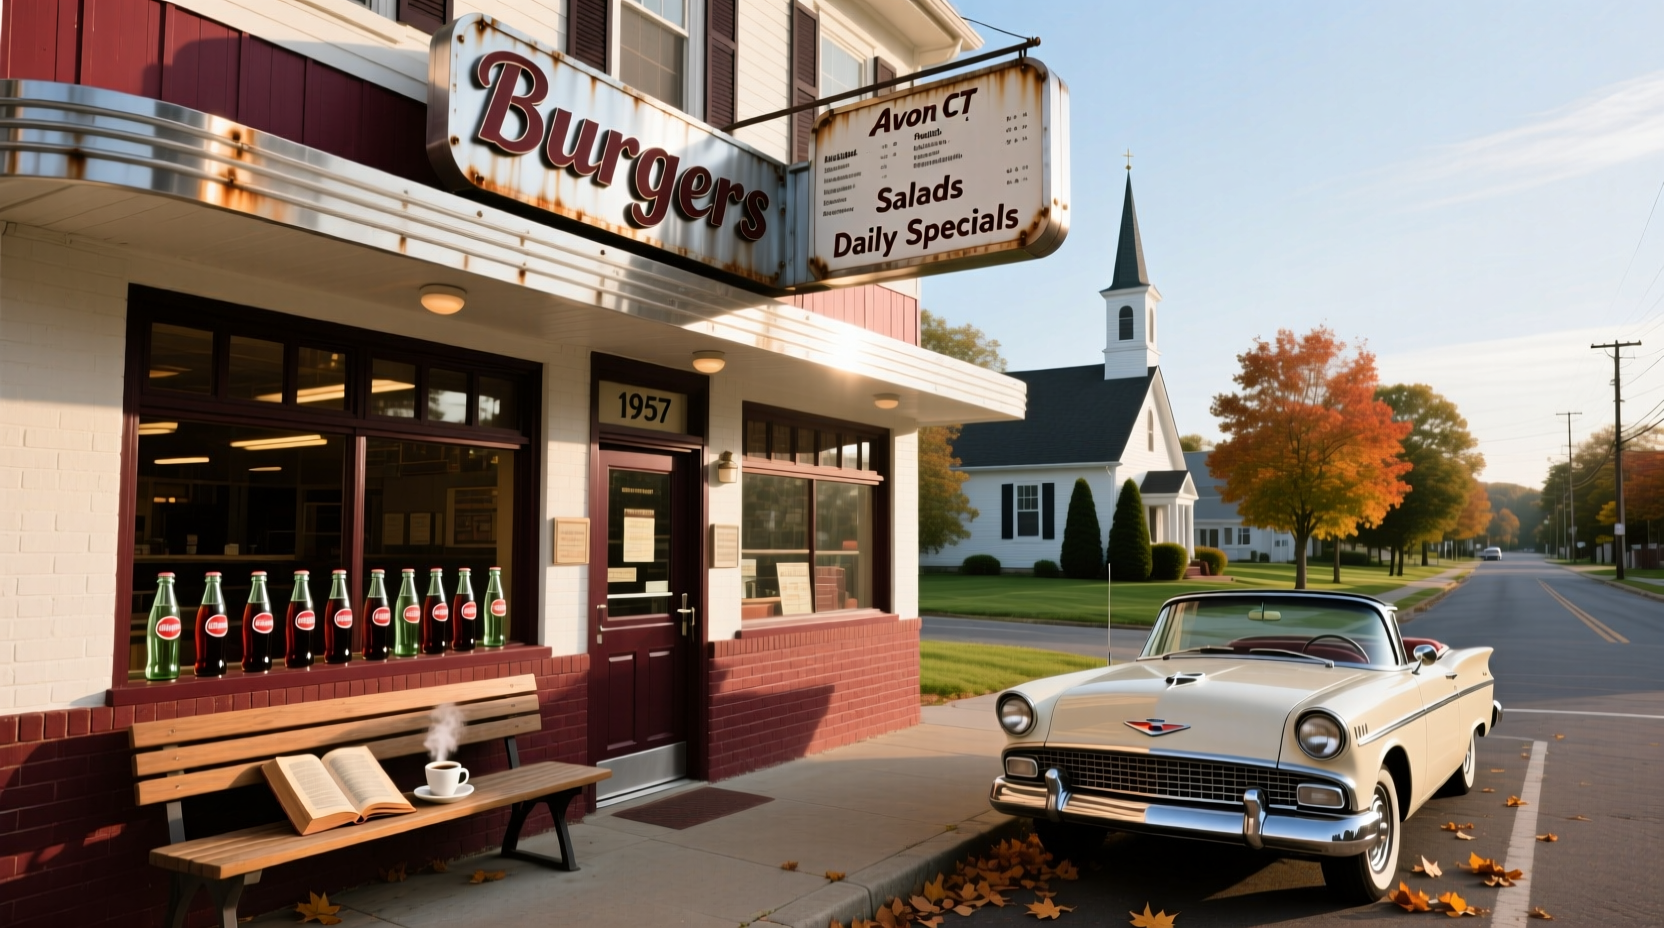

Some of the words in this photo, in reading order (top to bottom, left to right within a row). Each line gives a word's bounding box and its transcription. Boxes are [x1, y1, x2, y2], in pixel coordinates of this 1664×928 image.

[868, 102, 937, 137] Avon
[942, 87, 978, 118] CT
[476, 50, 770, 241] Burgers
[875, 175, 963, 213] Salads
[833, 226, 898, 258] Daily
[905, 203, 1019, 249] Specials
[618, 391, 672, 423] 1957
